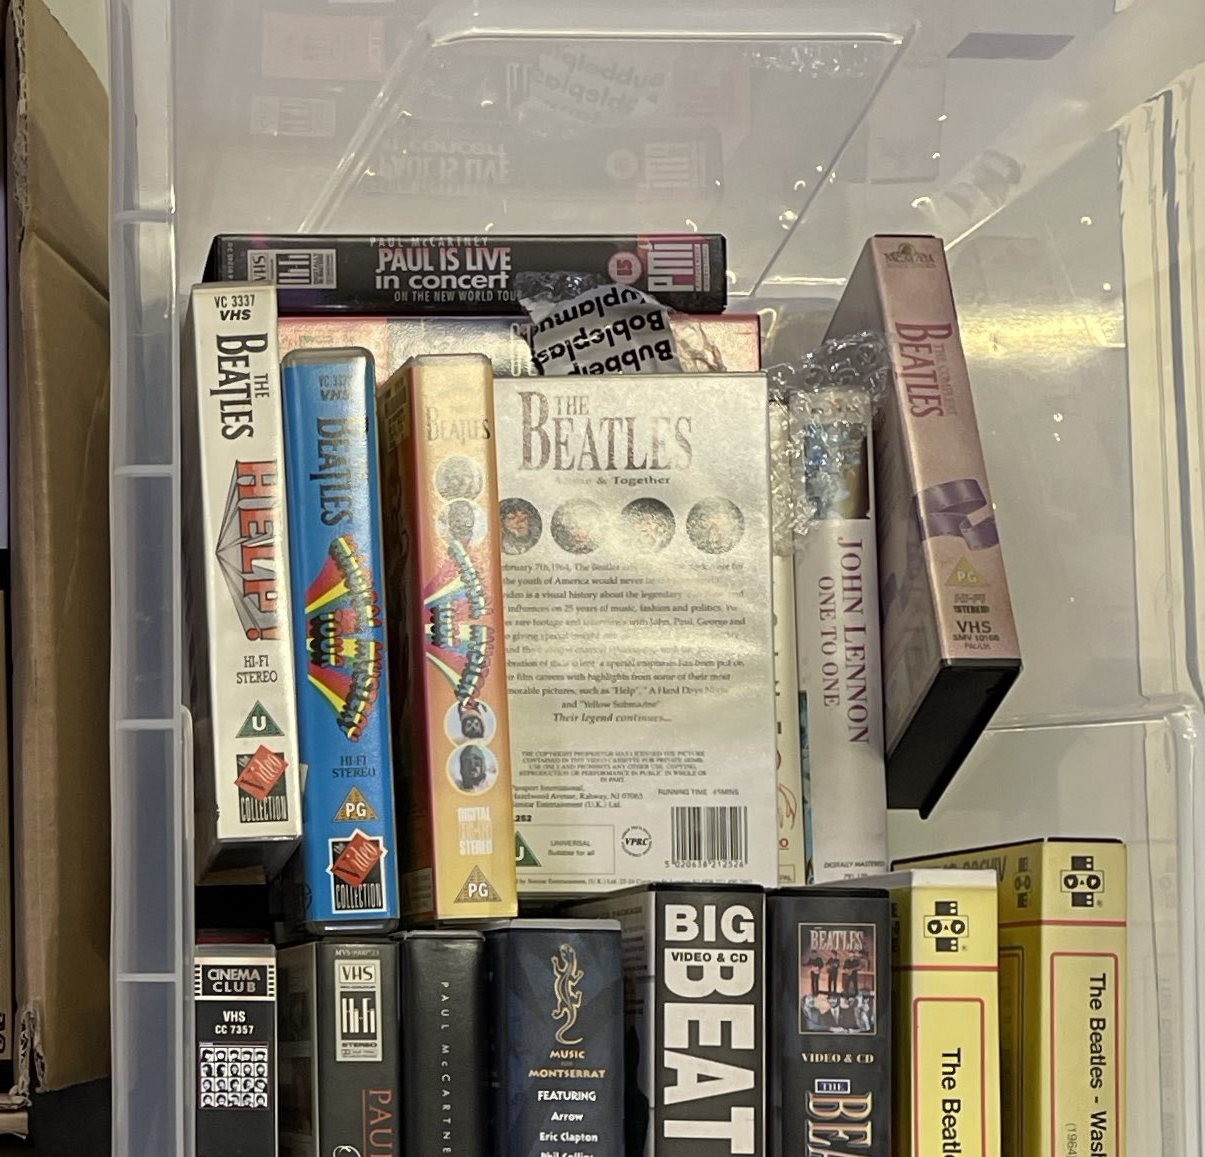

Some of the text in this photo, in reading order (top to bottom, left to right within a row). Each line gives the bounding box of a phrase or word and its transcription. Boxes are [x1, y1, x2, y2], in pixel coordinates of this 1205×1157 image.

[376, 248, 511, 273] PAUL IS LIVE
[376, 273, 509, 290] in concert
[214, 294, 255, 308] VC 3337
[220, 309, 251, 321] VHS
[210, 333, 268, 440] BEATLES
[956, 621, 991, 633] VHS
[818, 576, 840, 707] ONE TO ONE
[838, 538, 869, 744] JOHN LENNON
[244, 655, 269, 668] HI-FI
[236, 671, 277, 684] STEREO
[553, 713, 613, 724] Their legend
[664, 904, 755, 942] BIG
[671, 953, 748, 962] VIDEO & CD
[208, 969, 260, 981] CINEMA
[213, 982, 256, 992] CLUB
[223, 1011, 246, 1022] VHS
[215, 1025, 254, 1034] CC 7357
[664, 948, 755, 1154] BEAT
[941, 1048, 961, 1091] The
[538, 1091, 596, 1101] FEATURING
[540, 1133, 598, 1143] Eric Clapton
